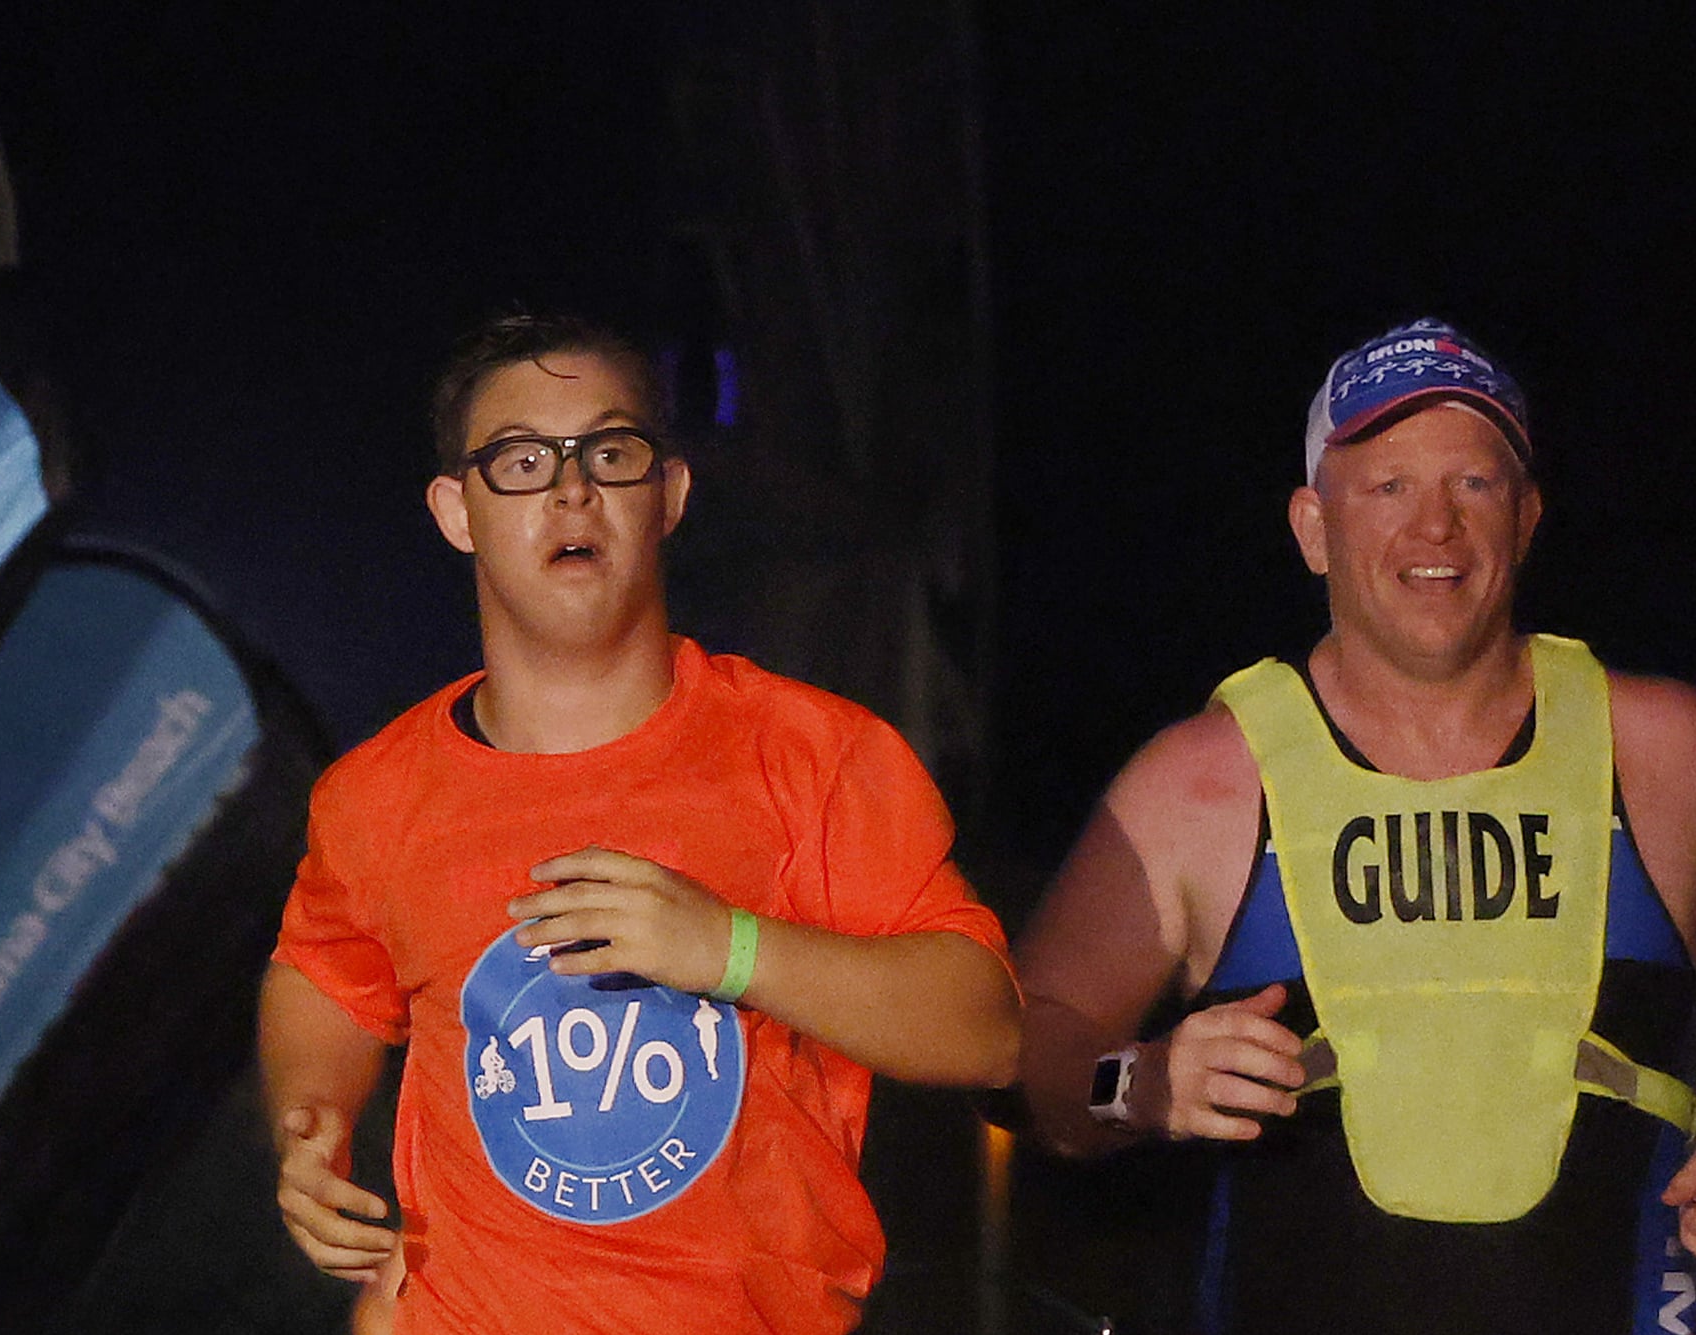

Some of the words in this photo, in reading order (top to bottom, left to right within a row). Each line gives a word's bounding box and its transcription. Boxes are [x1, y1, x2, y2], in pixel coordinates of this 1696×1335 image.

[1332, 810, 1562, 926] GUIDE
[507, 1000, 686, 1122] 1%
[523, 1137, 697, 1211] BETTER
